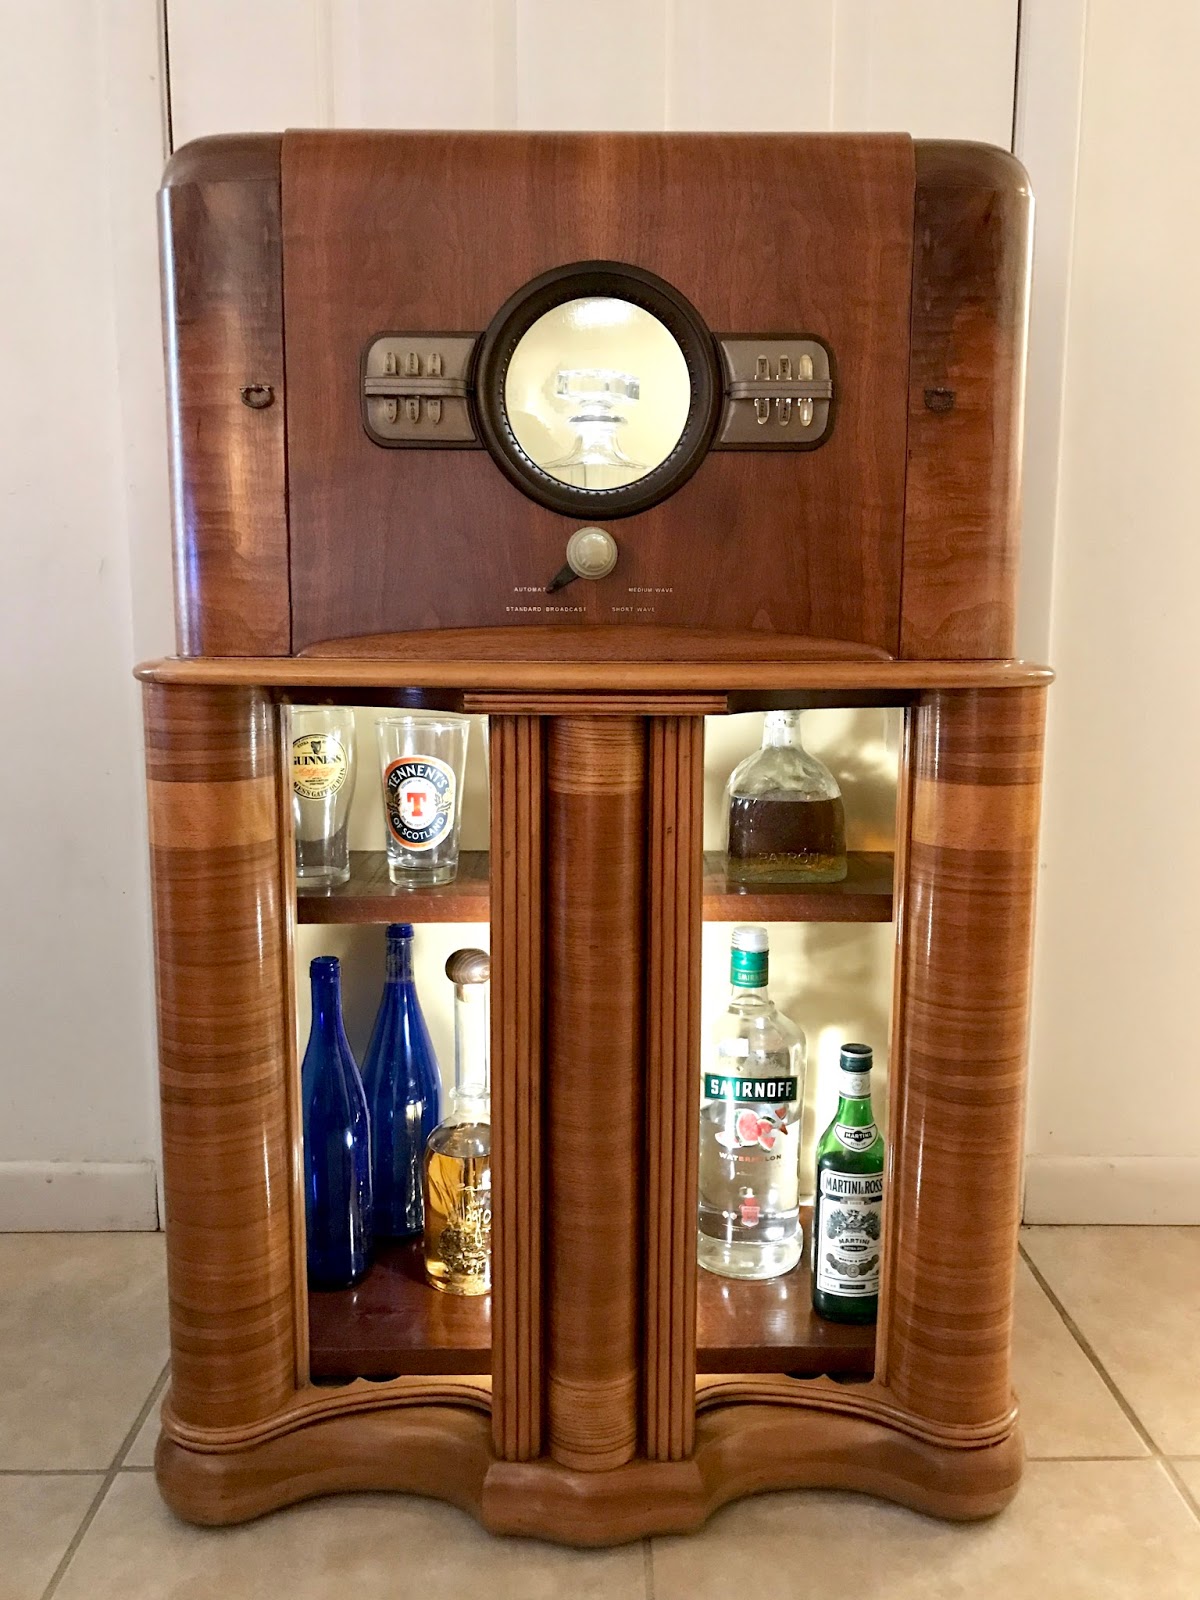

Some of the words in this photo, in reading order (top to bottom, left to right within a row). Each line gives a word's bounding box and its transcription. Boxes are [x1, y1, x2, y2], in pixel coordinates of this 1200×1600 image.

[388, 765, 448, 788] TENNENT'S
[406, 792, 427, 817] T
[392, 817, 404, 829] OF
[401, 816, 445, 840] SCOTLAND
[710, 1079, 793, 1098] SMIRNOFF
[718, 1151, 782, 1162] WATERMLON
